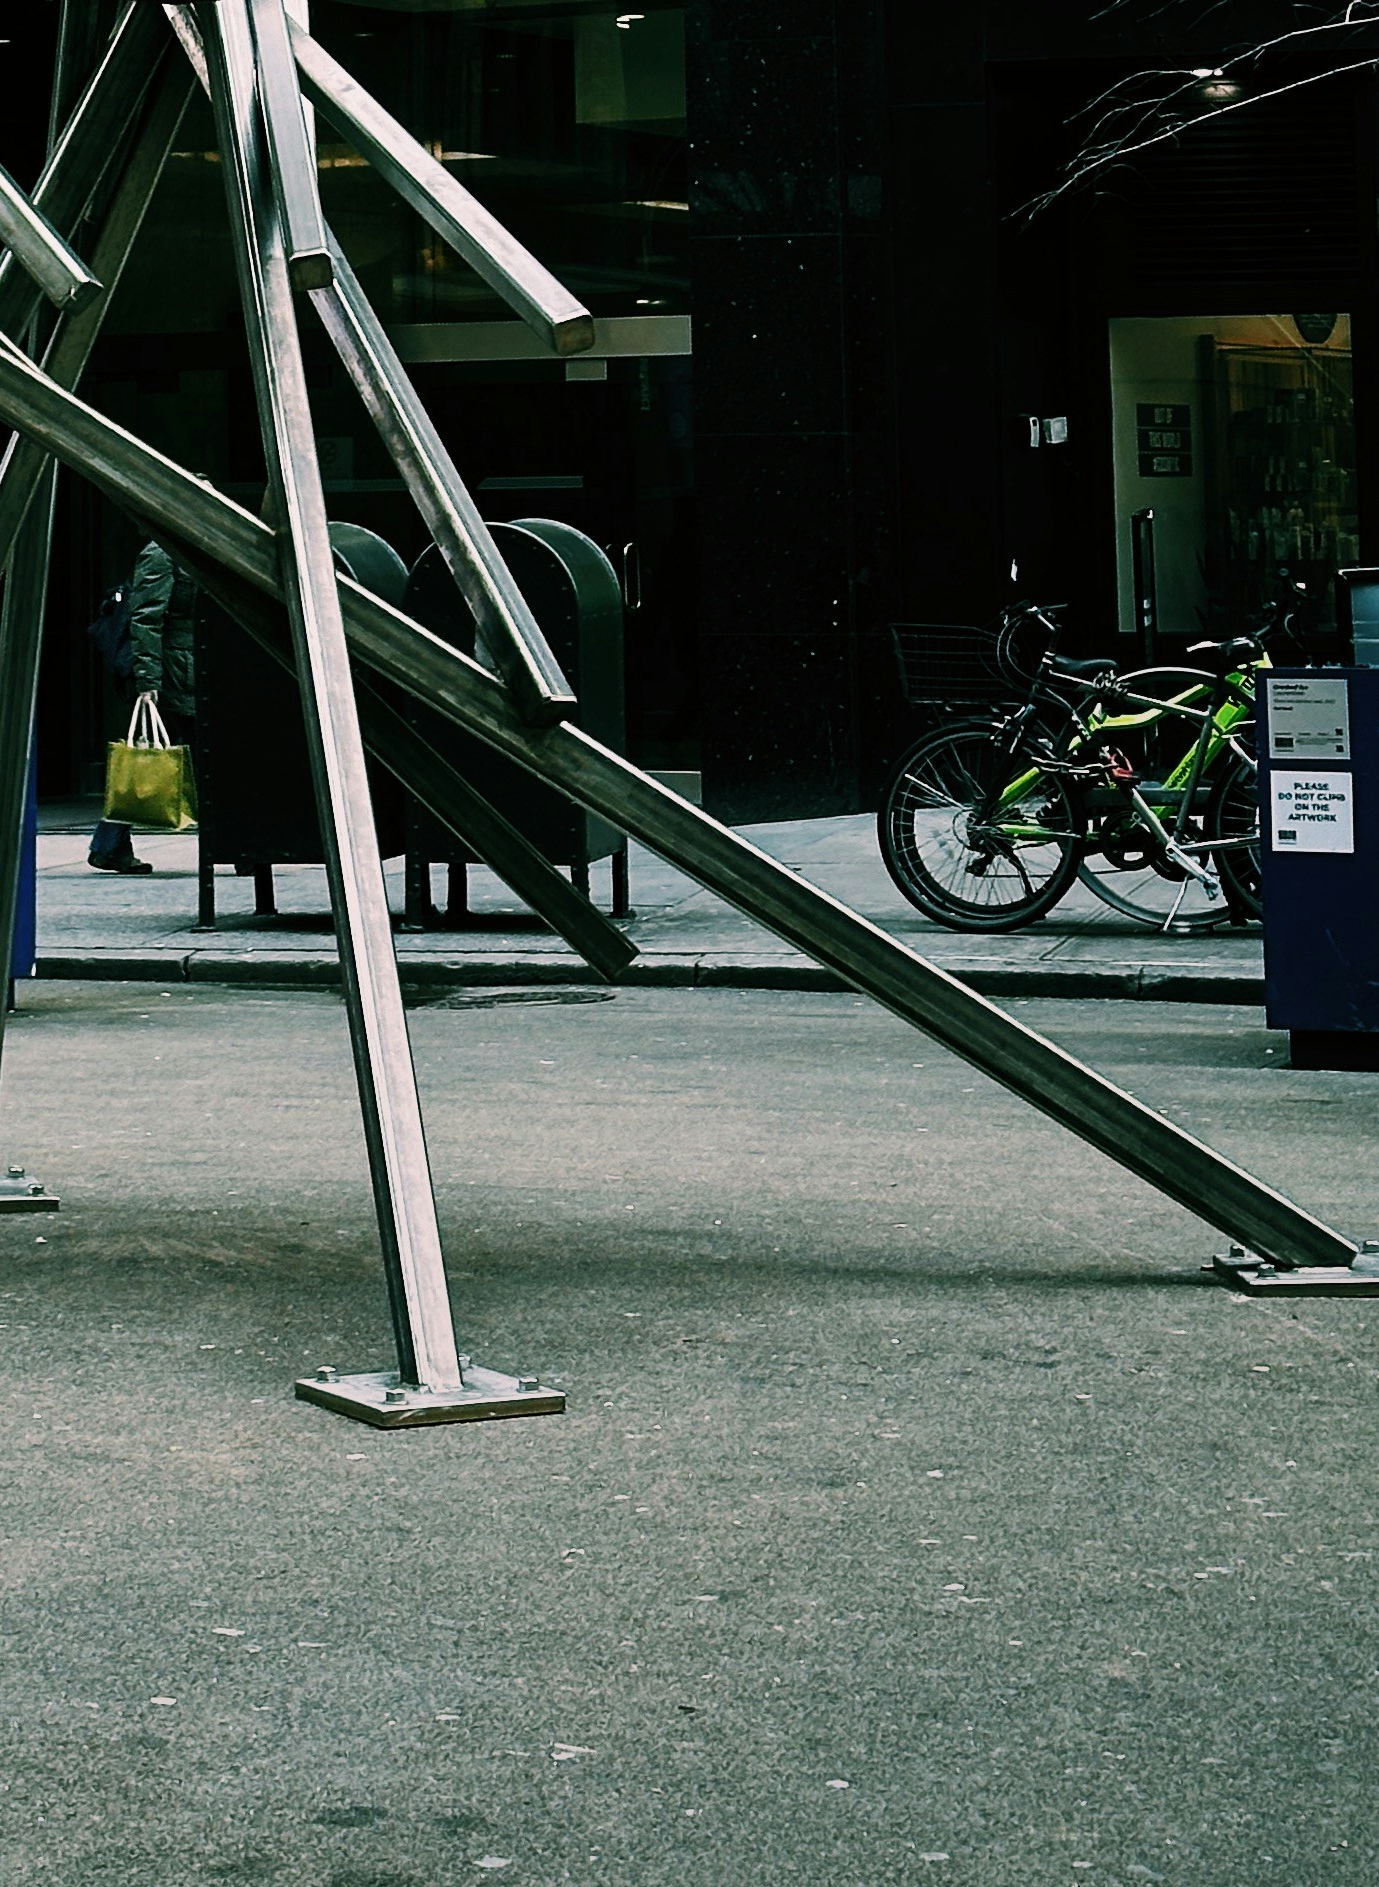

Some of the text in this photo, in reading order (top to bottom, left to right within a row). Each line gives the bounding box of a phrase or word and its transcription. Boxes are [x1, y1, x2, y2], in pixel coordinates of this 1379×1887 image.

[1293, 782, 1330, 791] PLEASE
[1277, 792, 1346, 802] DO NOT CLIMB
[1294, 803, 1330, 812] ON THE
[1287, 813, 1337, 823] ARTWORK
